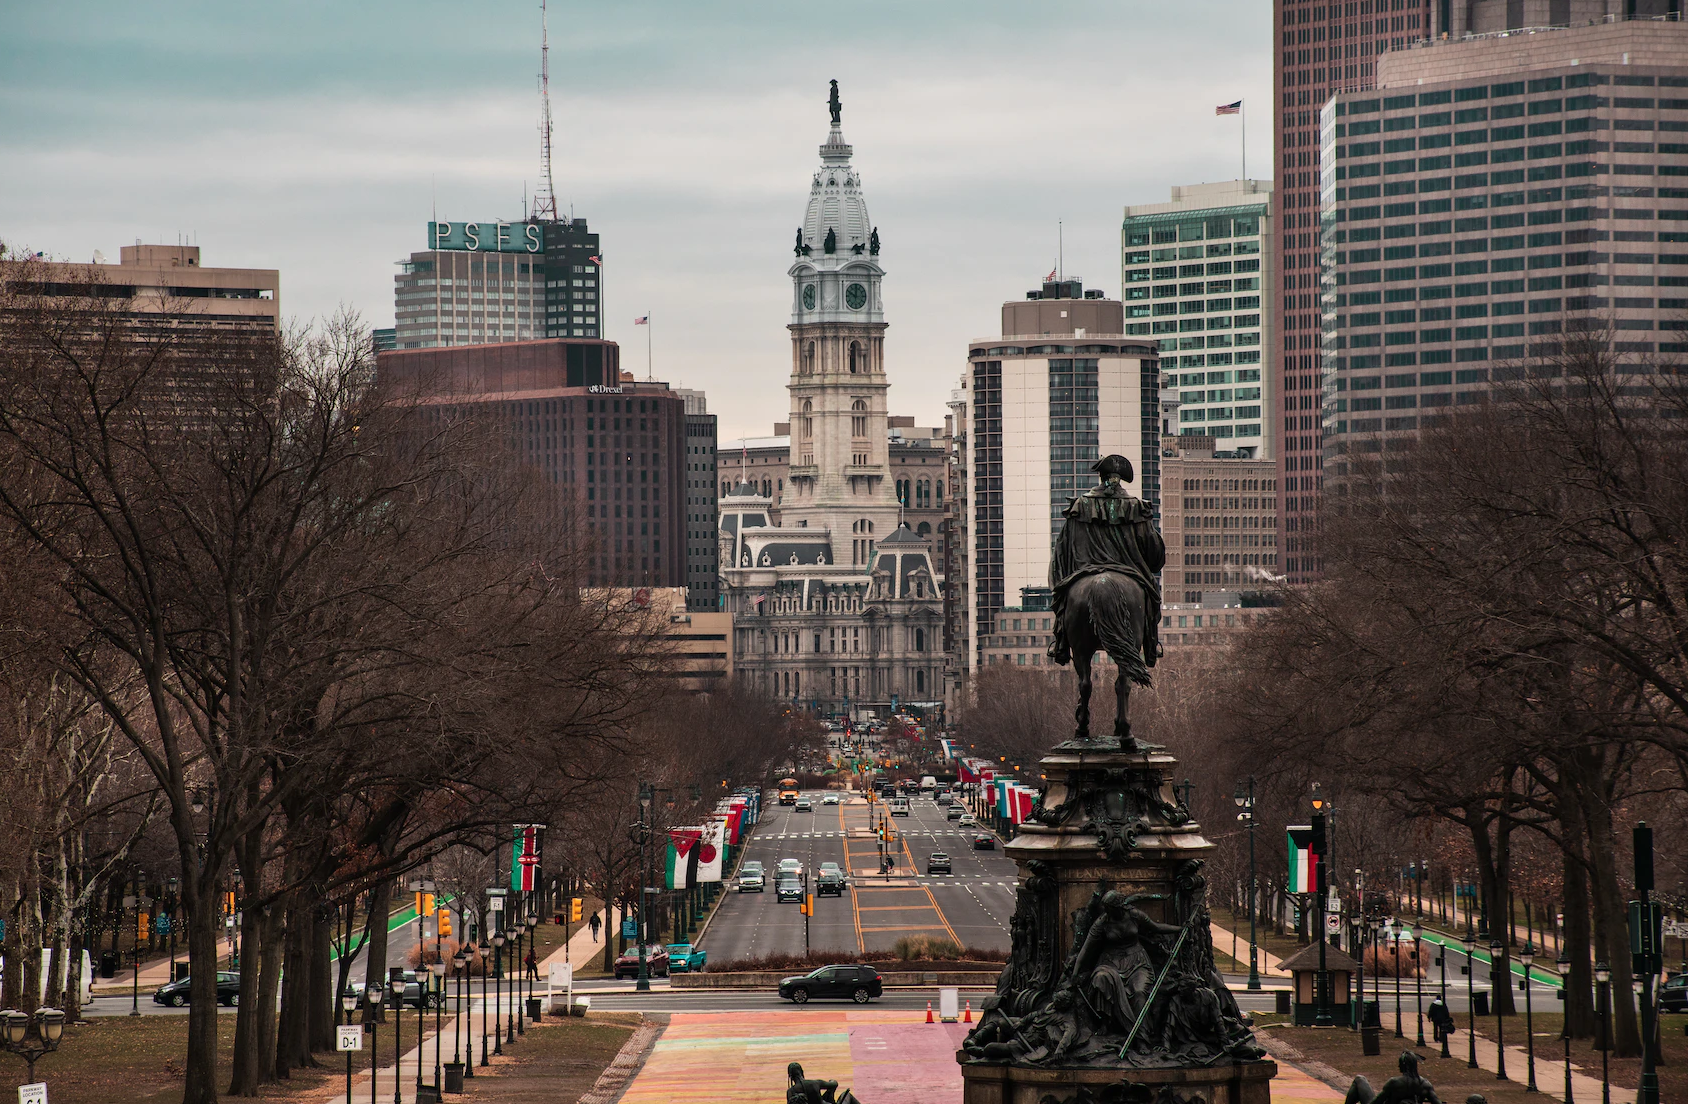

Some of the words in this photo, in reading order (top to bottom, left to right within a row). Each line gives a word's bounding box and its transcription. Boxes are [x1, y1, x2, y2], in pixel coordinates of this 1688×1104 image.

[436, 221, 539, 252] PSFS
[600, 384, 623, 394] Drexel
[342, 1036, 357, 1048] D-1
[22, 1090, 43, 1098] LOCATION
